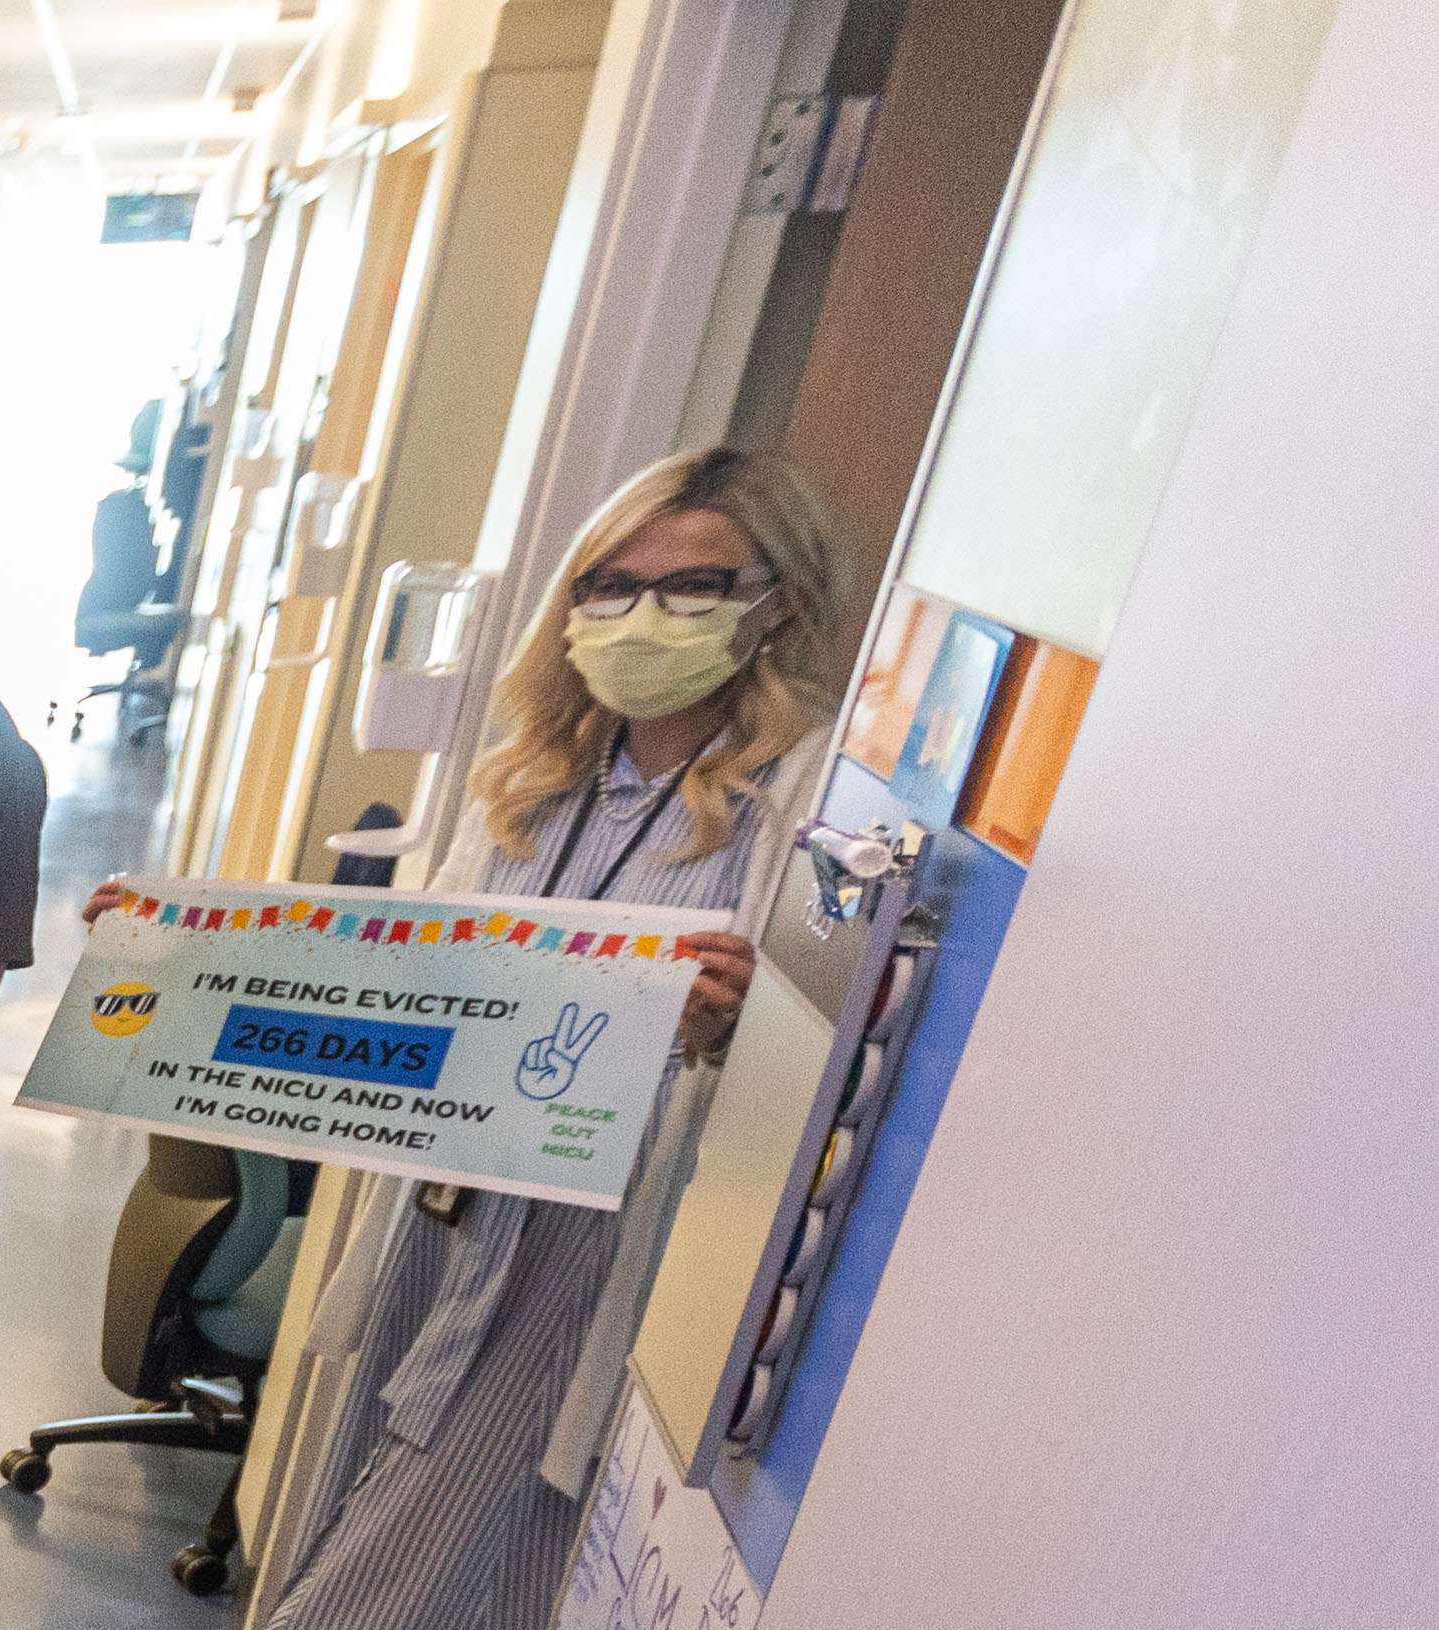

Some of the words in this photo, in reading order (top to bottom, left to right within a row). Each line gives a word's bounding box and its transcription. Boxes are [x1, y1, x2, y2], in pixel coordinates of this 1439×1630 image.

[193, 972, 239, 994] I'M
[244, 977, 348, 1006] BEING
[356, 989, 520, 1021] EVICTED!
[232, 1022, 308, 1058] 266
[316, 1032, 431, 1073] DAYS
[148, 1059, 181, 1079] IN
[187, 1065, 247, 1089] THE
[251, 1075, 329, 1101] NICU
[331, 1087, 405, 1113] AND
[410, 1098, 495, 1124] NOW
[174, 1095, 218, 1117] I'M
[224, 1105, 322, 1133] GOING
[328, 1119, 437, 1152] HOME!
